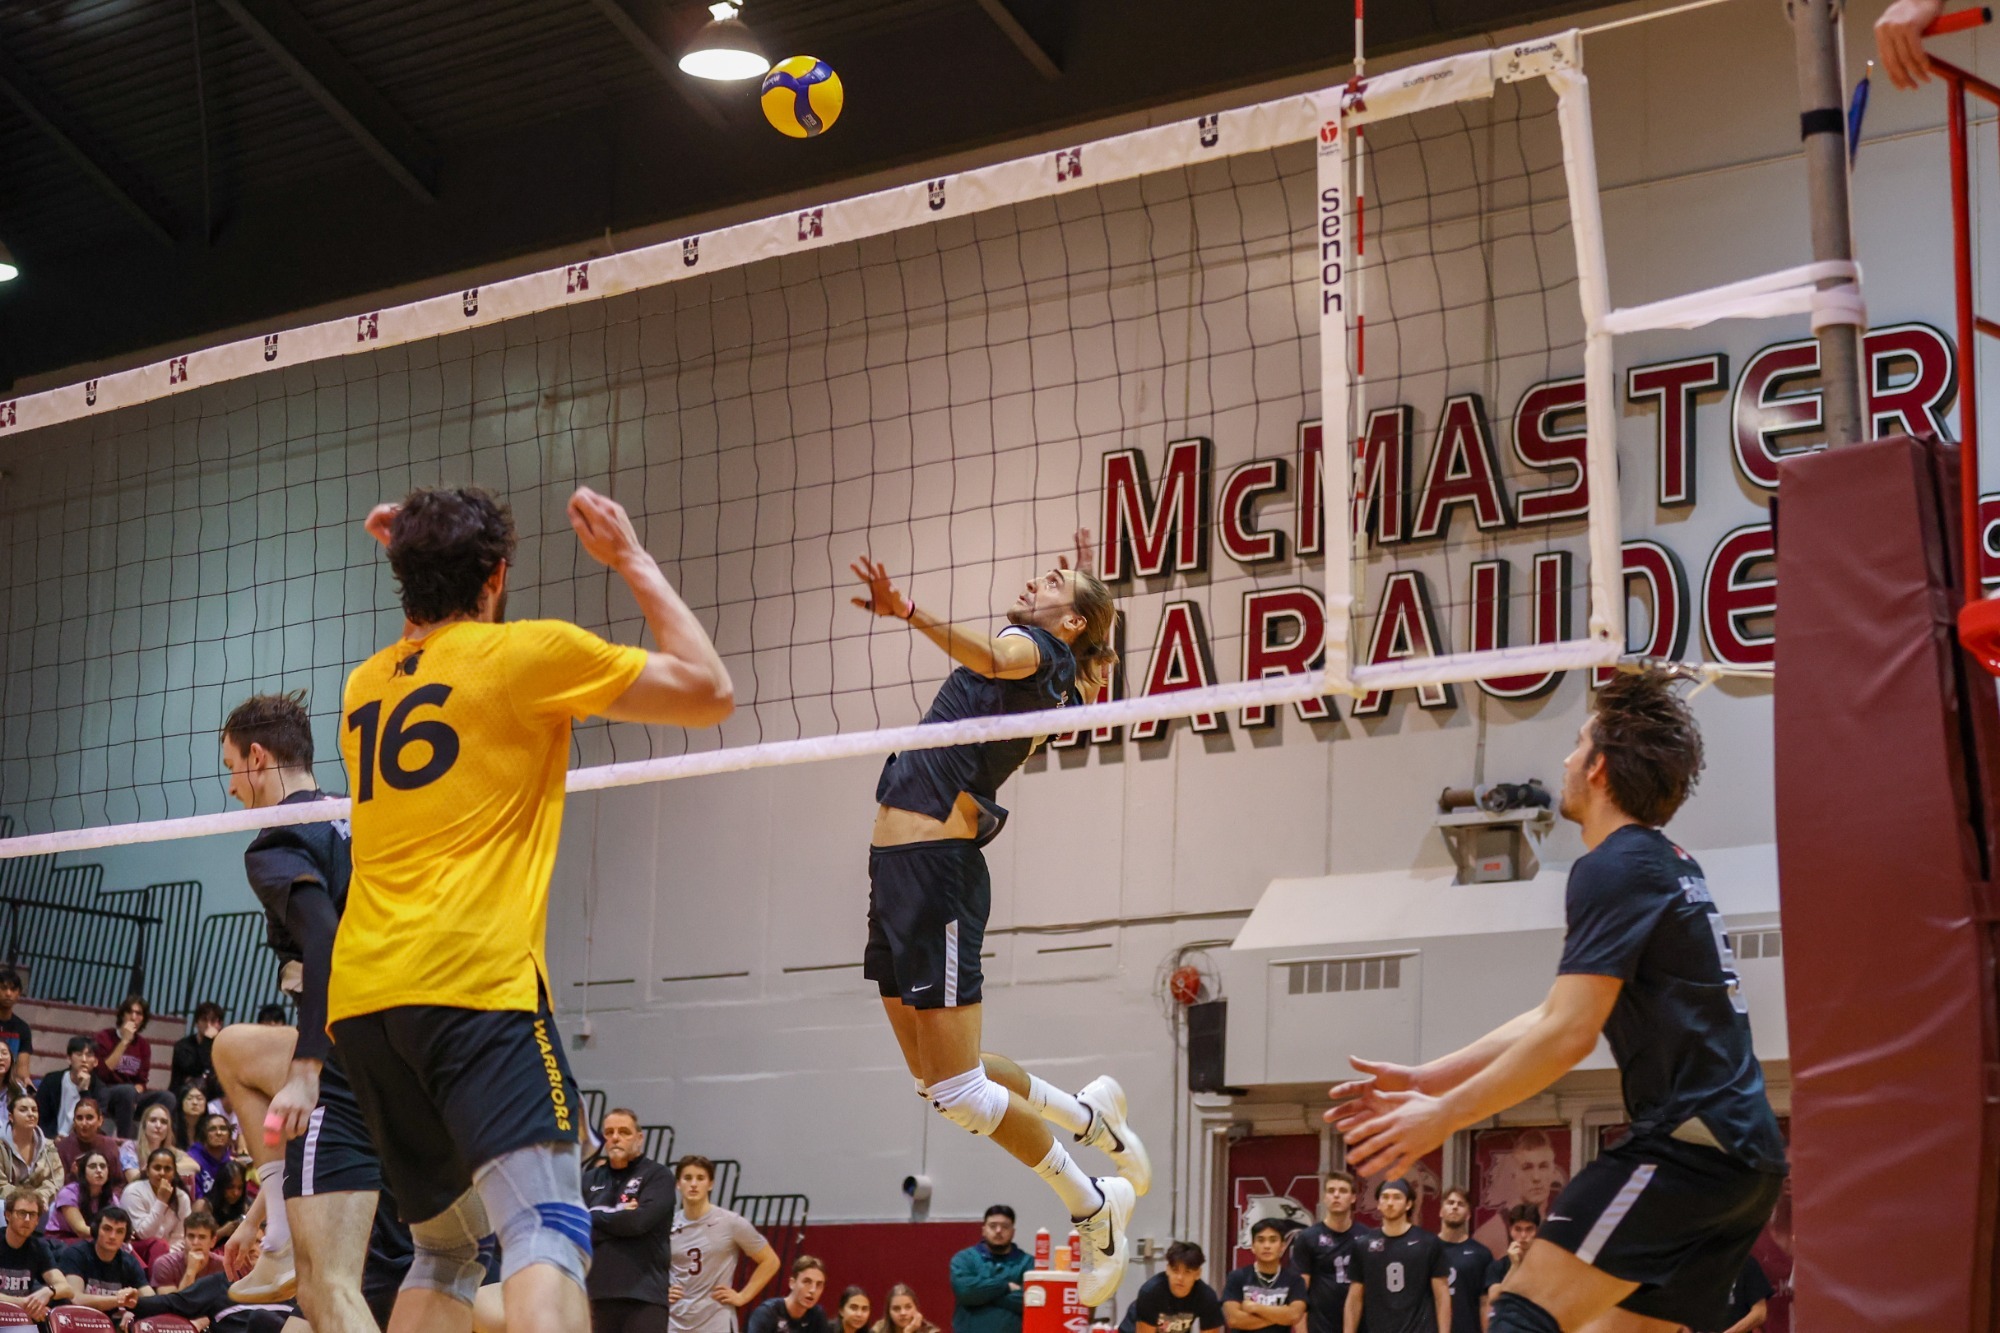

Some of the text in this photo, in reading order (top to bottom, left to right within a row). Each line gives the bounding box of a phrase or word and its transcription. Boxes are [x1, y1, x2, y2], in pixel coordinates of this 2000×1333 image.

[348, 683, 459, 804] 16
[533, 1019, 571, 1131] WARRIORS
[687, 1247, 702, 1276] 3
[1386, 1261, 1405, 1292] 8
